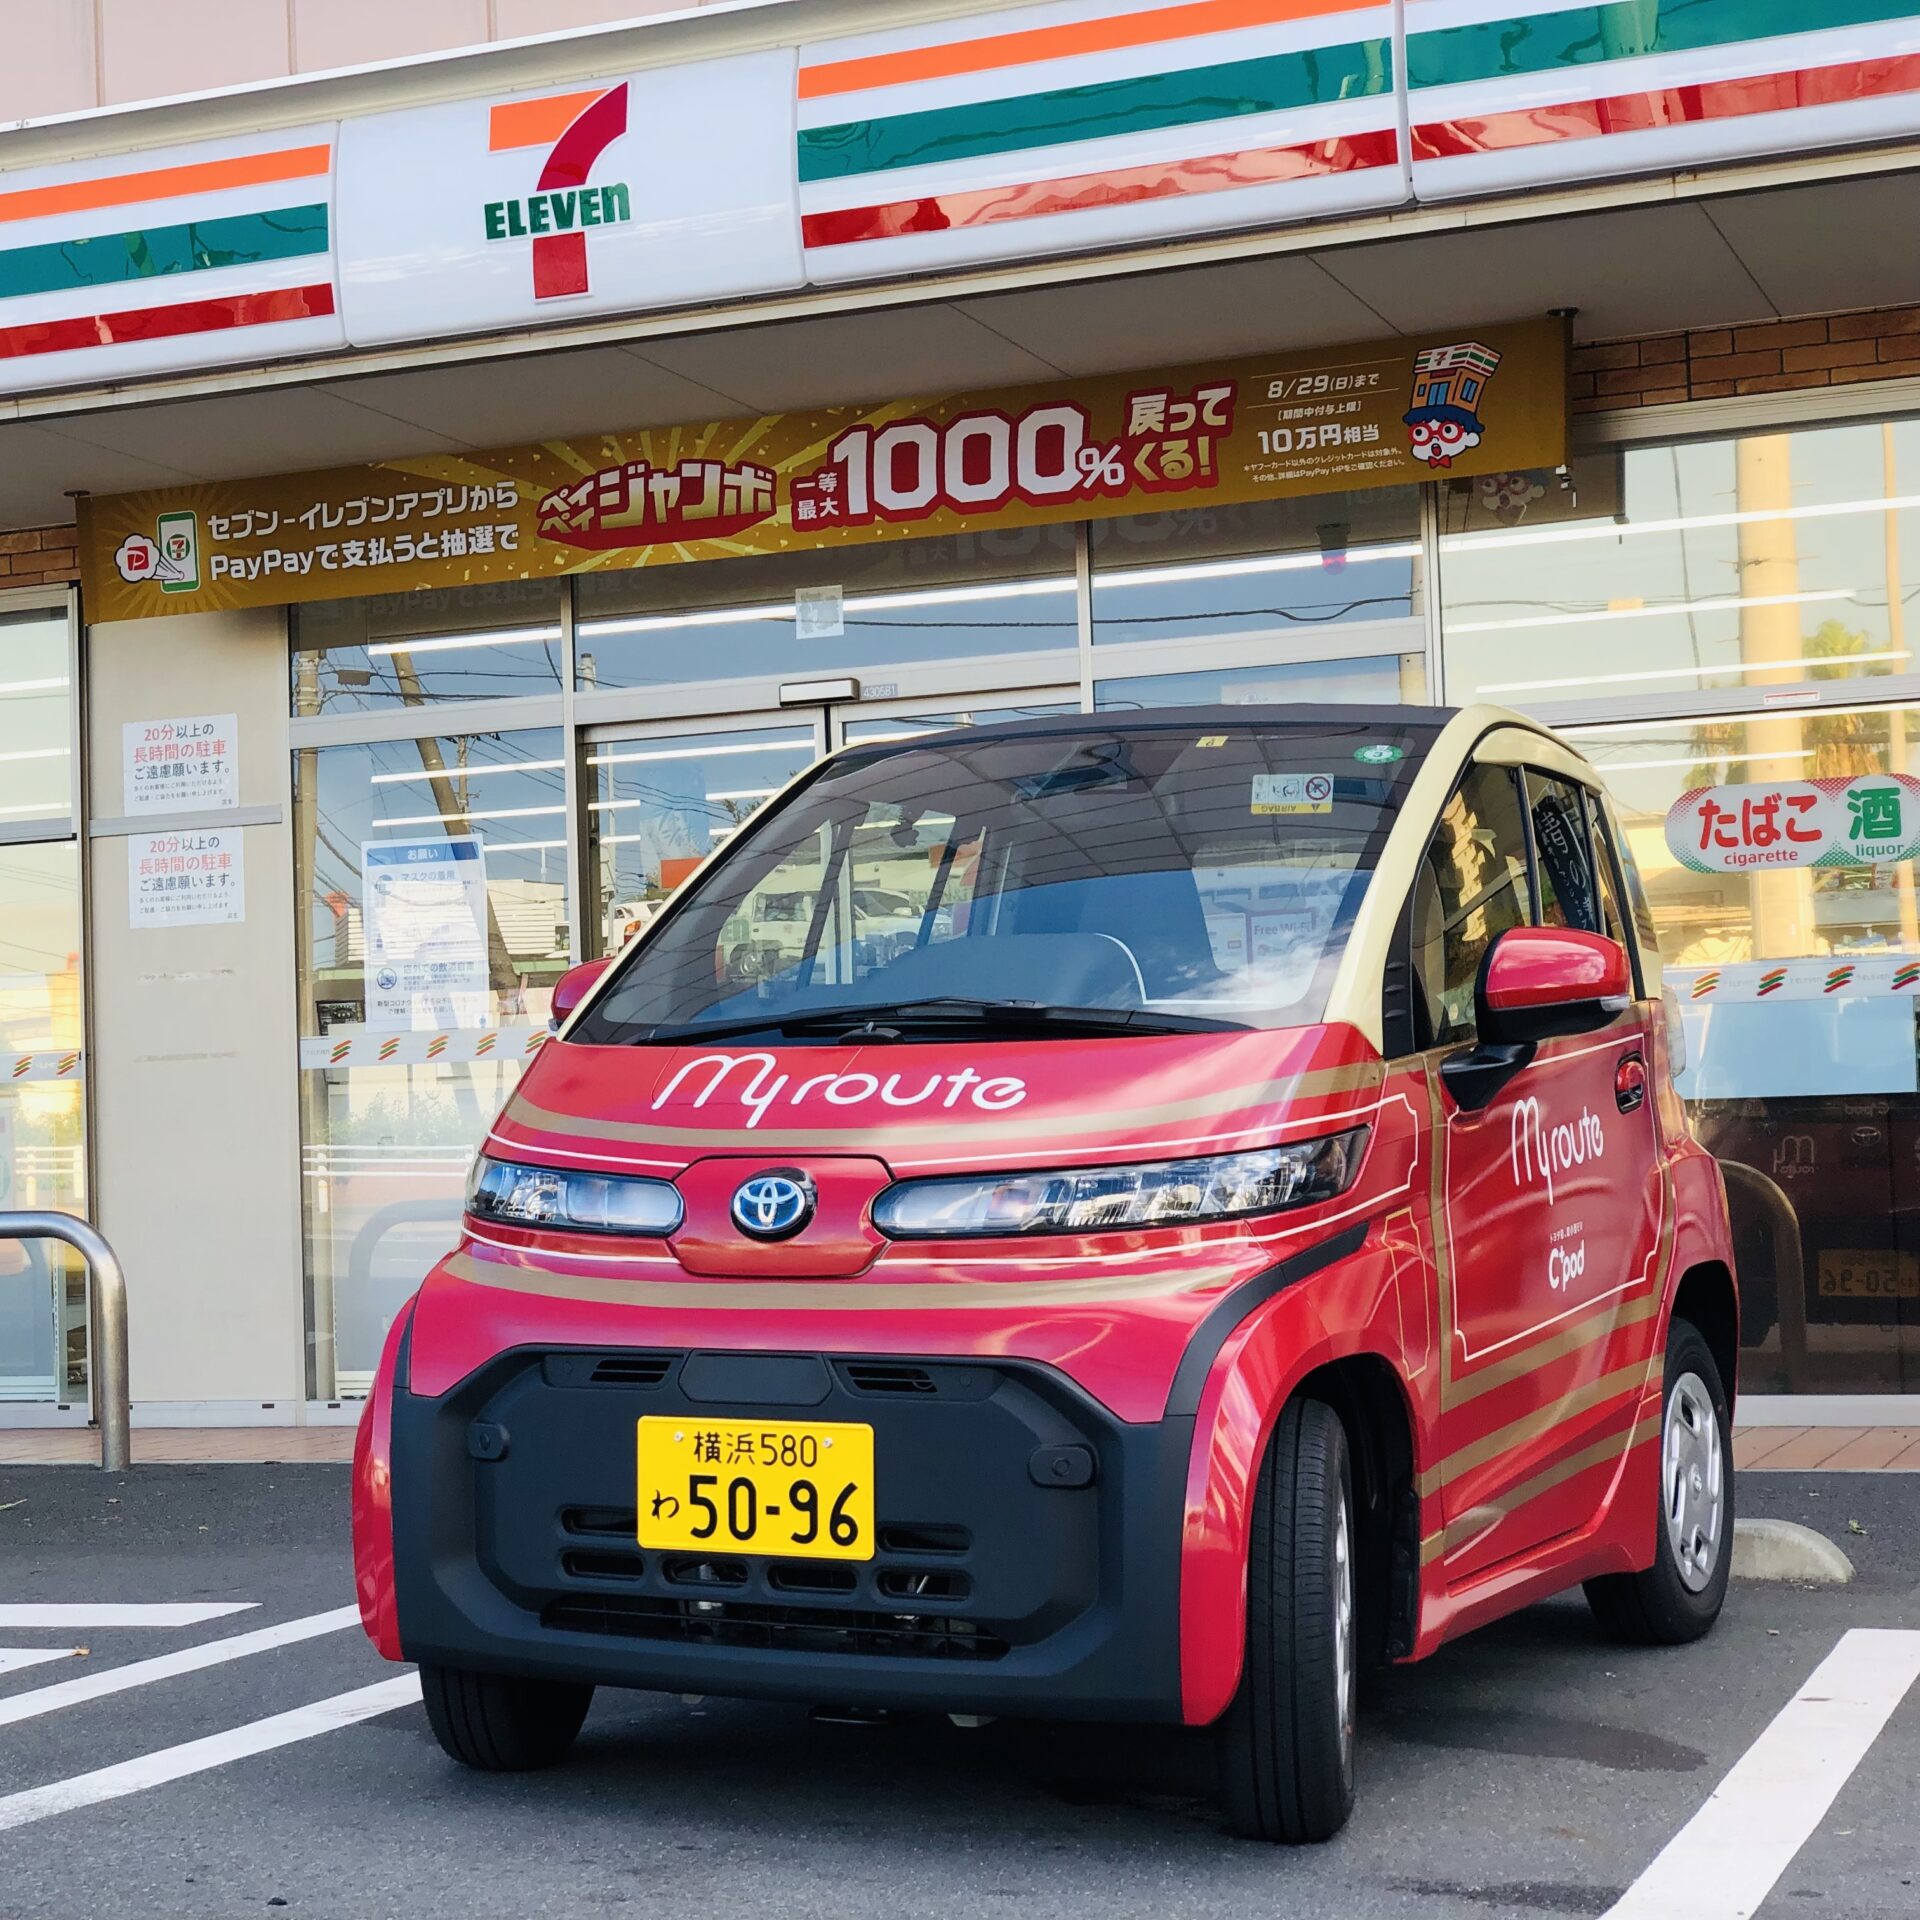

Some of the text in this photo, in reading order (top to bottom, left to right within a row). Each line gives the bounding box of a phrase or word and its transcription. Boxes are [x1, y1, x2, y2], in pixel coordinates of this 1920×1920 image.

[1267, 373, 1380, 399] 8/29(日)まで
[1128, 386, 1232, 437] 戻って
[1257, 423, 1380, 455] 10万円相当
[600, 463, 773, 530] ジャンボ
[798, 497, 840, 521] 最大
[210, 523, 519, 581] PayPayで支払うと抽選で
[144, 723, 215, 742] 20分以上の
[134, 739, 228, 764] 長時間の駐車
[134, 760, 230, 781] ご遠慮願います。
[1698, 792, 1823, 850] たばこ
[1847, 787, 1902, 840] 酒
[150, 836, 220, 854] 20分以上の
[1855, 843, 1905, 859] liquor
[139, 852, 233, 876] 長時間の駐車
[1724, 849, 1799, 867] cigarette
[140, 872, 236, 892] ご遠慮願います。
[651, 1473, 859, 1547] わ 50-96
